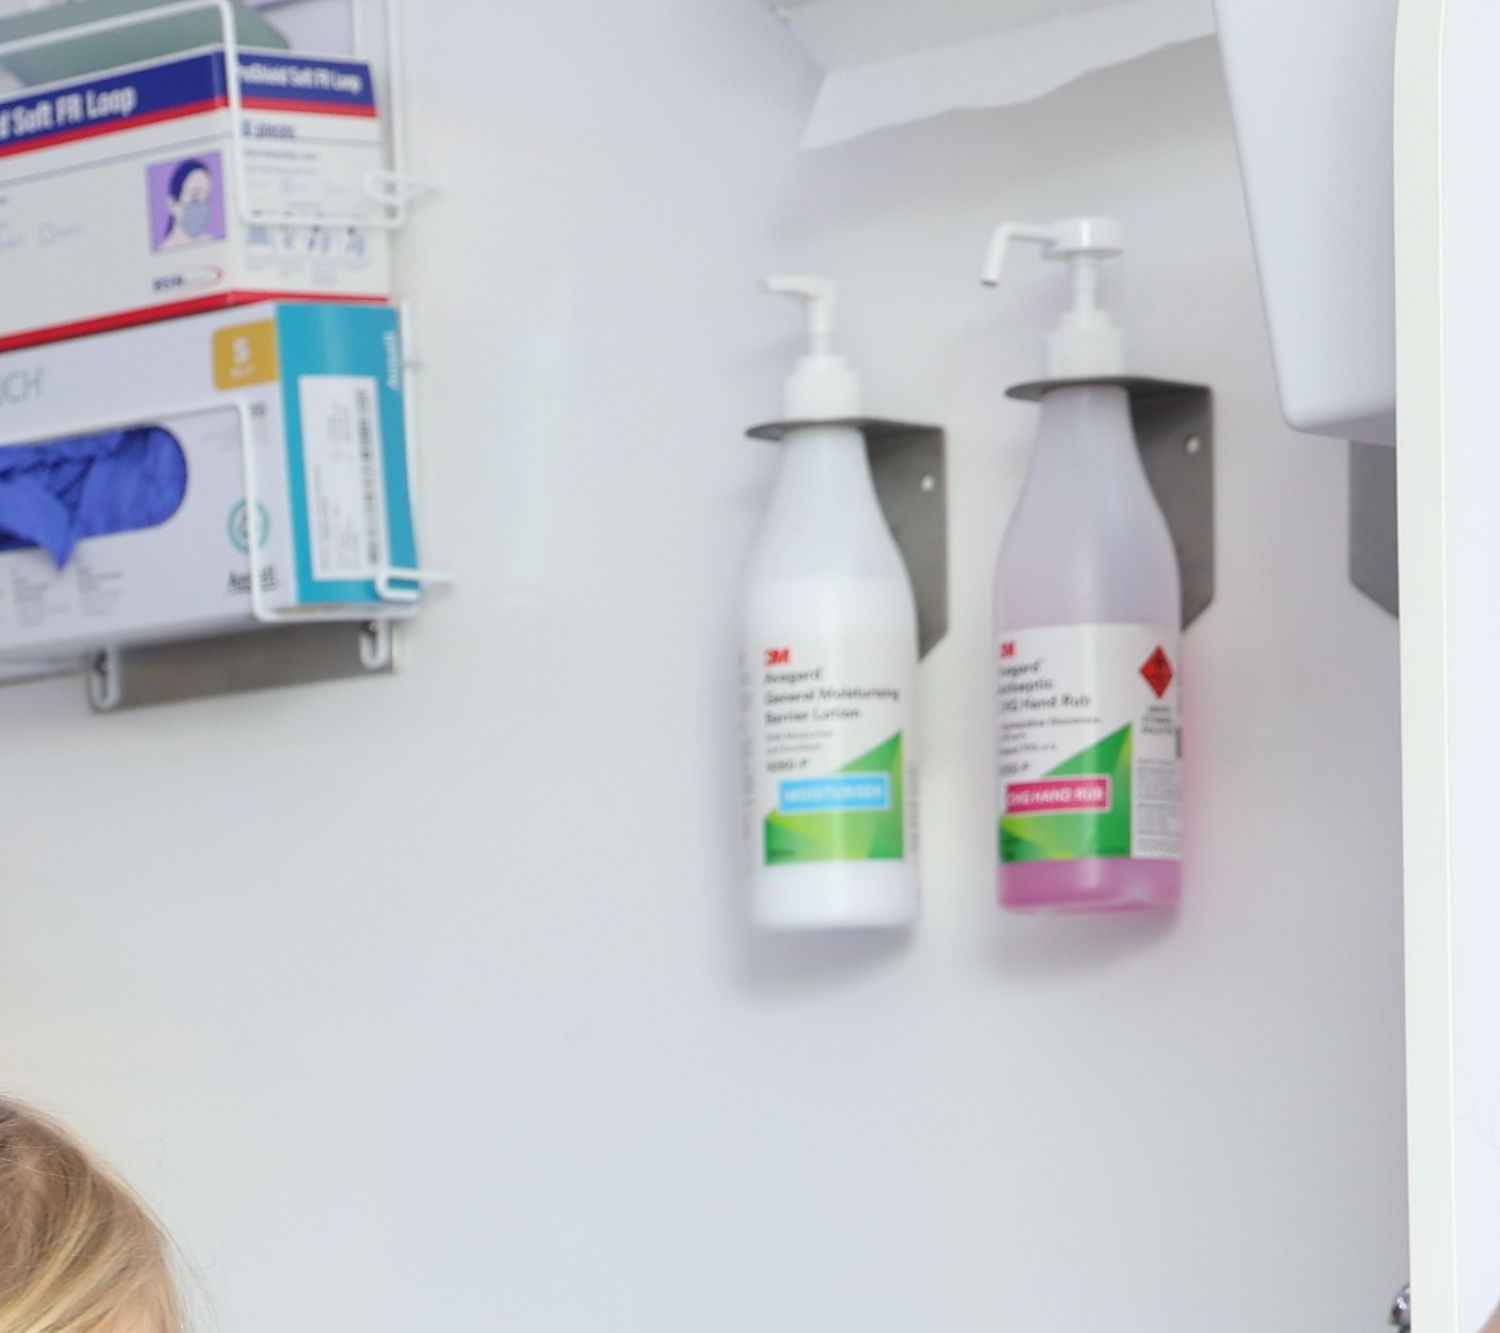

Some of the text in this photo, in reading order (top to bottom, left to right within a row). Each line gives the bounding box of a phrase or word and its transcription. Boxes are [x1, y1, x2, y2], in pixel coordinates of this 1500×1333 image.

[11, 101, 54, 136] Soft
[55, 93, 84, 124] FR
[85, 86, 138, 117] Loop
[231, 336, 251, 364] S
[764, 648, 791, 666] 3M
